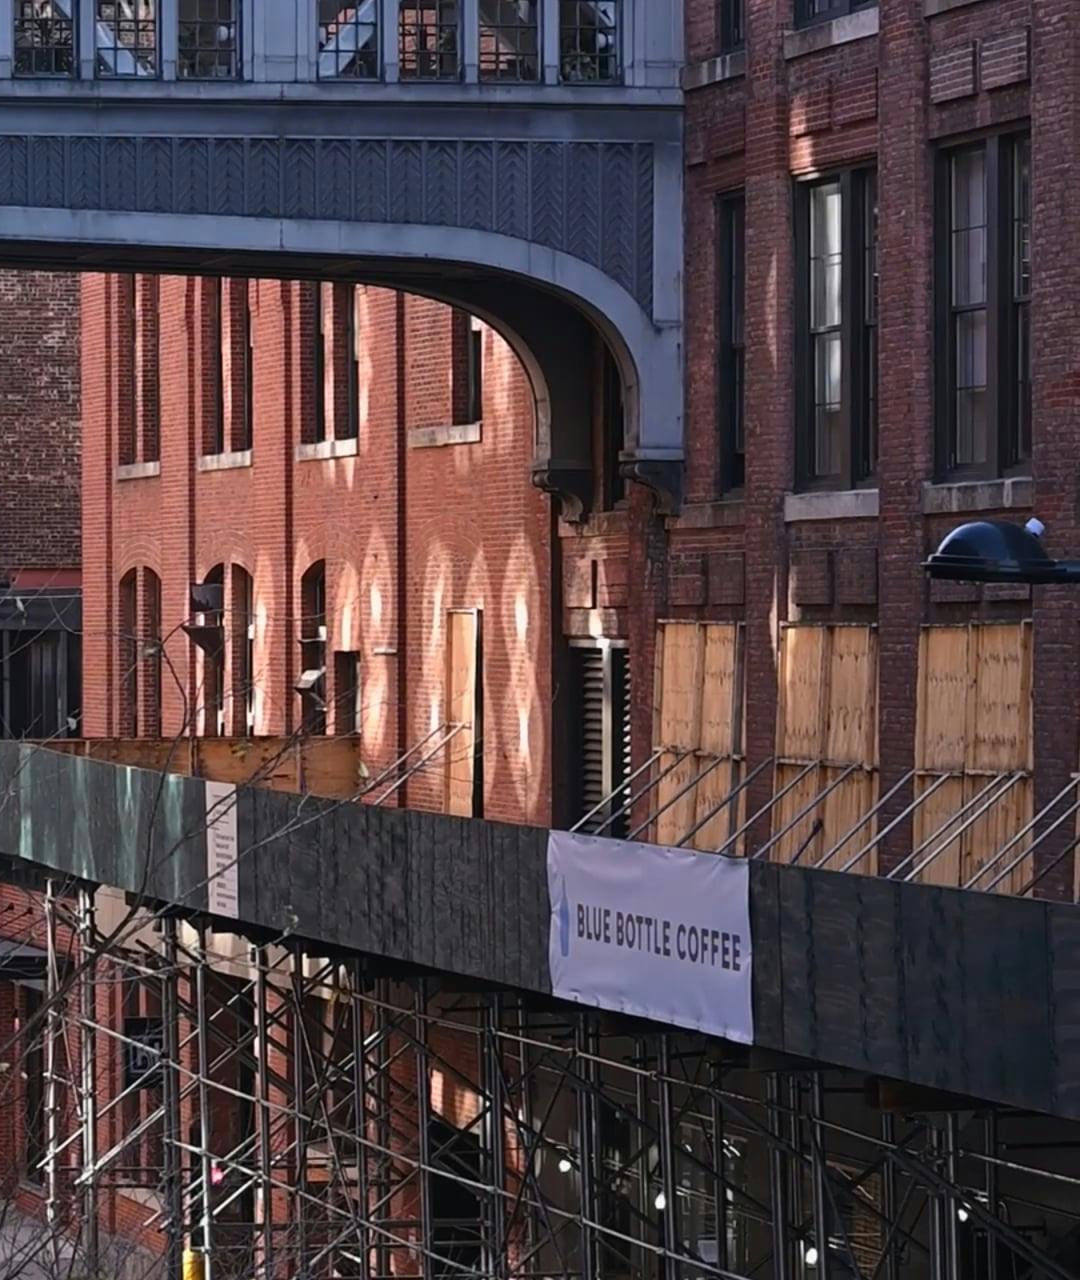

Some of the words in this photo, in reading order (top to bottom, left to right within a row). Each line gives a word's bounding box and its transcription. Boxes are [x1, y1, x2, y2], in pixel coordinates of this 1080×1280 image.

[577, 903, 611, 944] BLUE
[616, 911, 671, 957] BOTTLE
[676, 923, 741, 972] COFFEE
